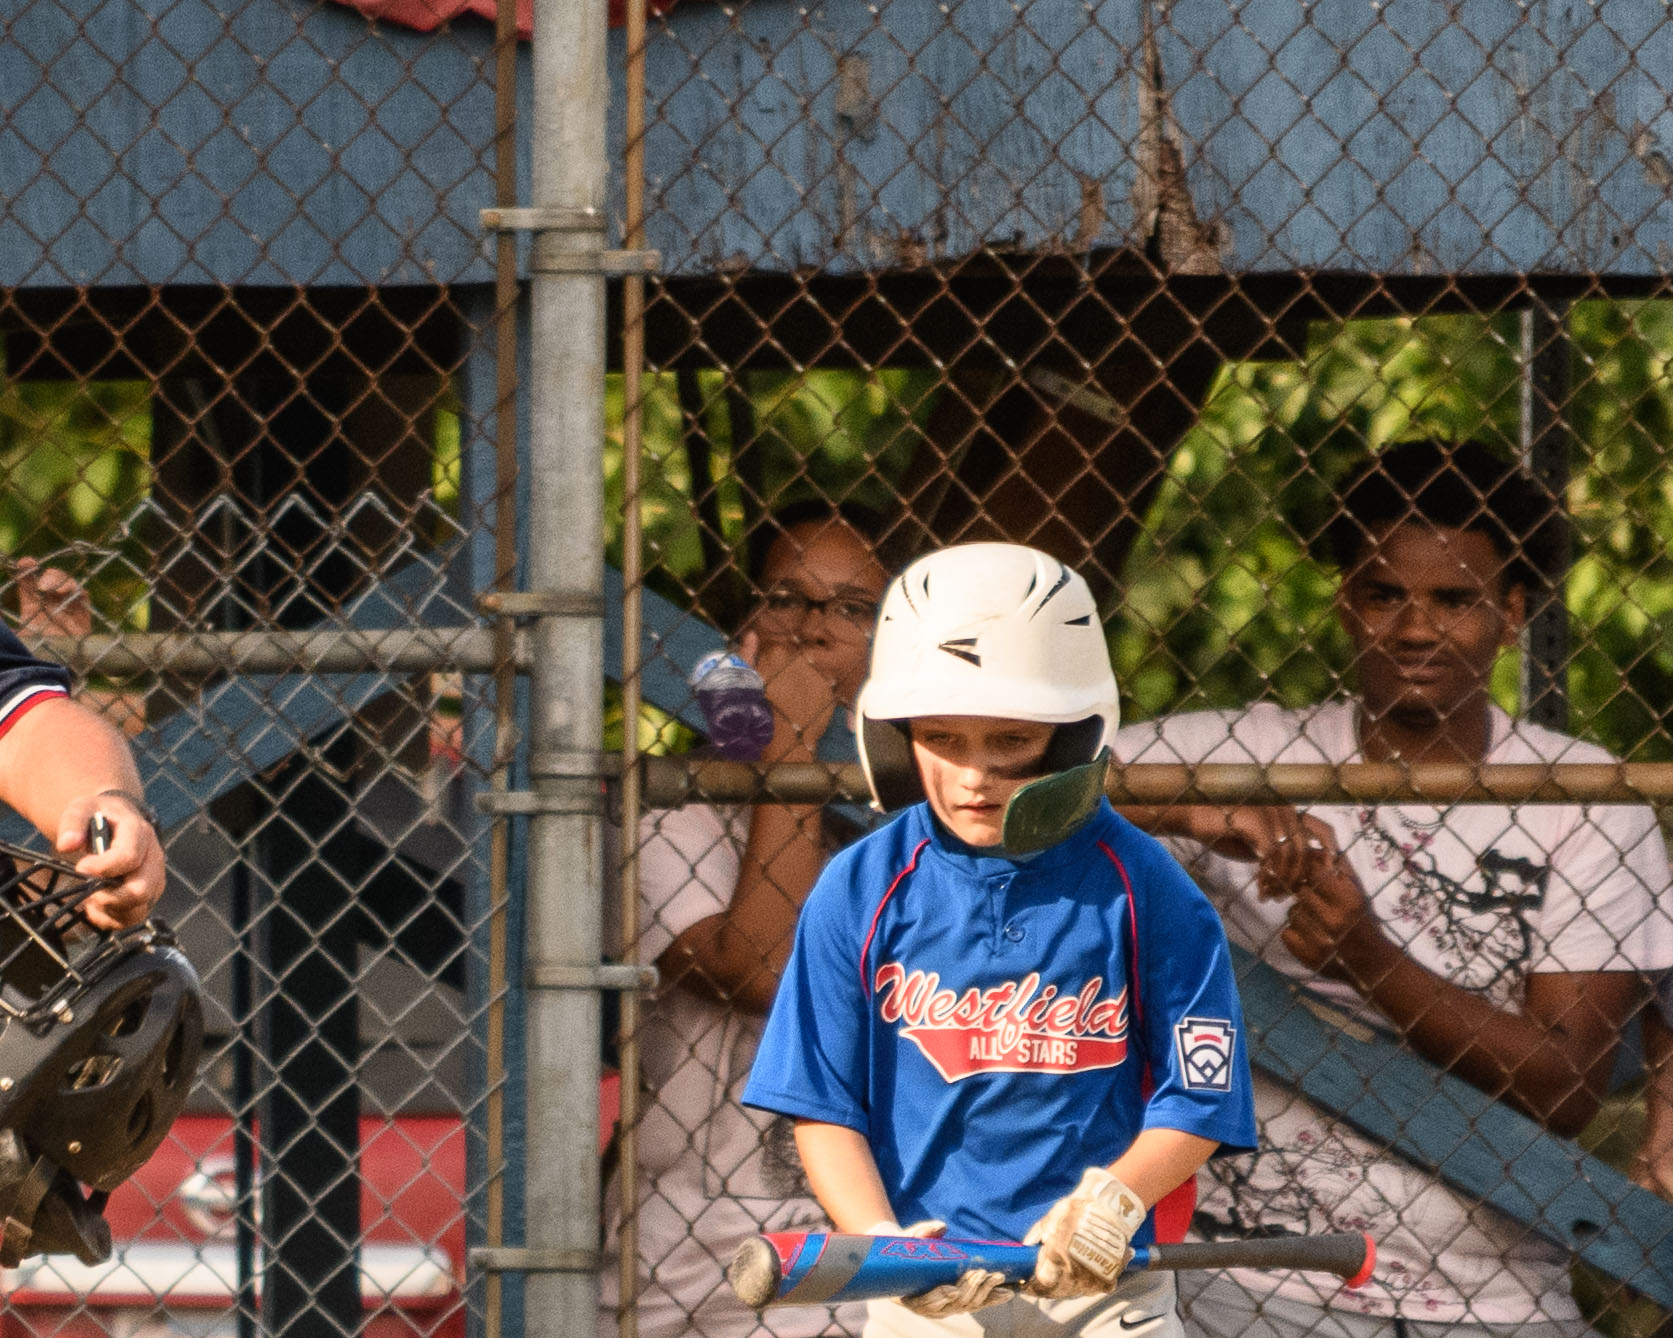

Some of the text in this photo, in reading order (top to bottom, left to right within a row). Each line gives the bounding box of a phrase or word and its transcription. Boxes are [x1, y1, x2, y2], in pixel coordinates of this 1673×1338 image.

[875, 962, 1128, 1054] Westfield
[969, 1036, 1078, 1065] ALL STARS
